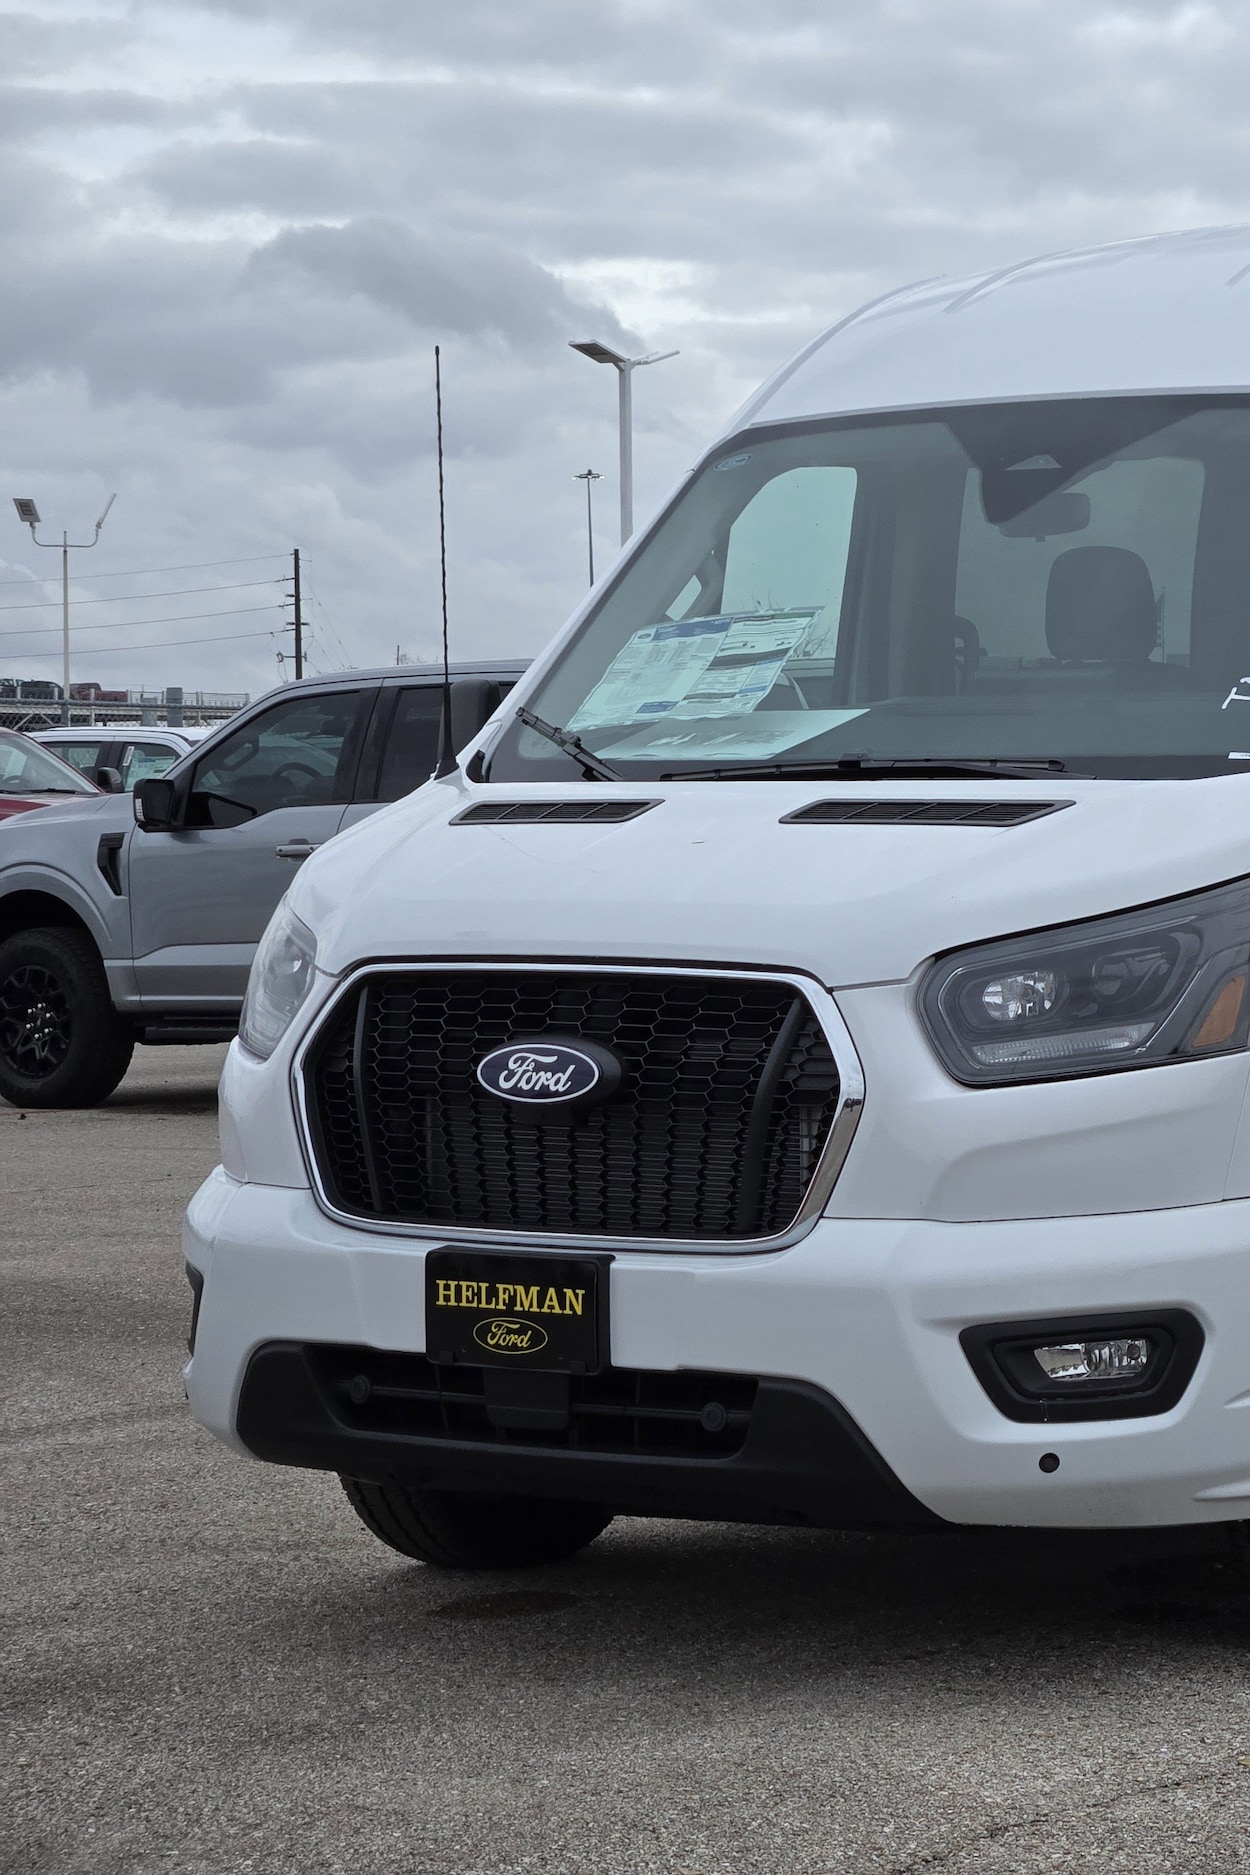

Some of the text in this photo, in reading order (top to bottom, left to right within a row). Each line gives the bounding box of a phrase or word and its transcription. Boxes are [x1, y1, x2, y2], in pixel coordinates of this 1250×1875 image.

[499, 1052, 576, 1092] Ford
[435, 1279, 586, 1316] HELFMAN
[487, 1320, 532, 1348] Ford
